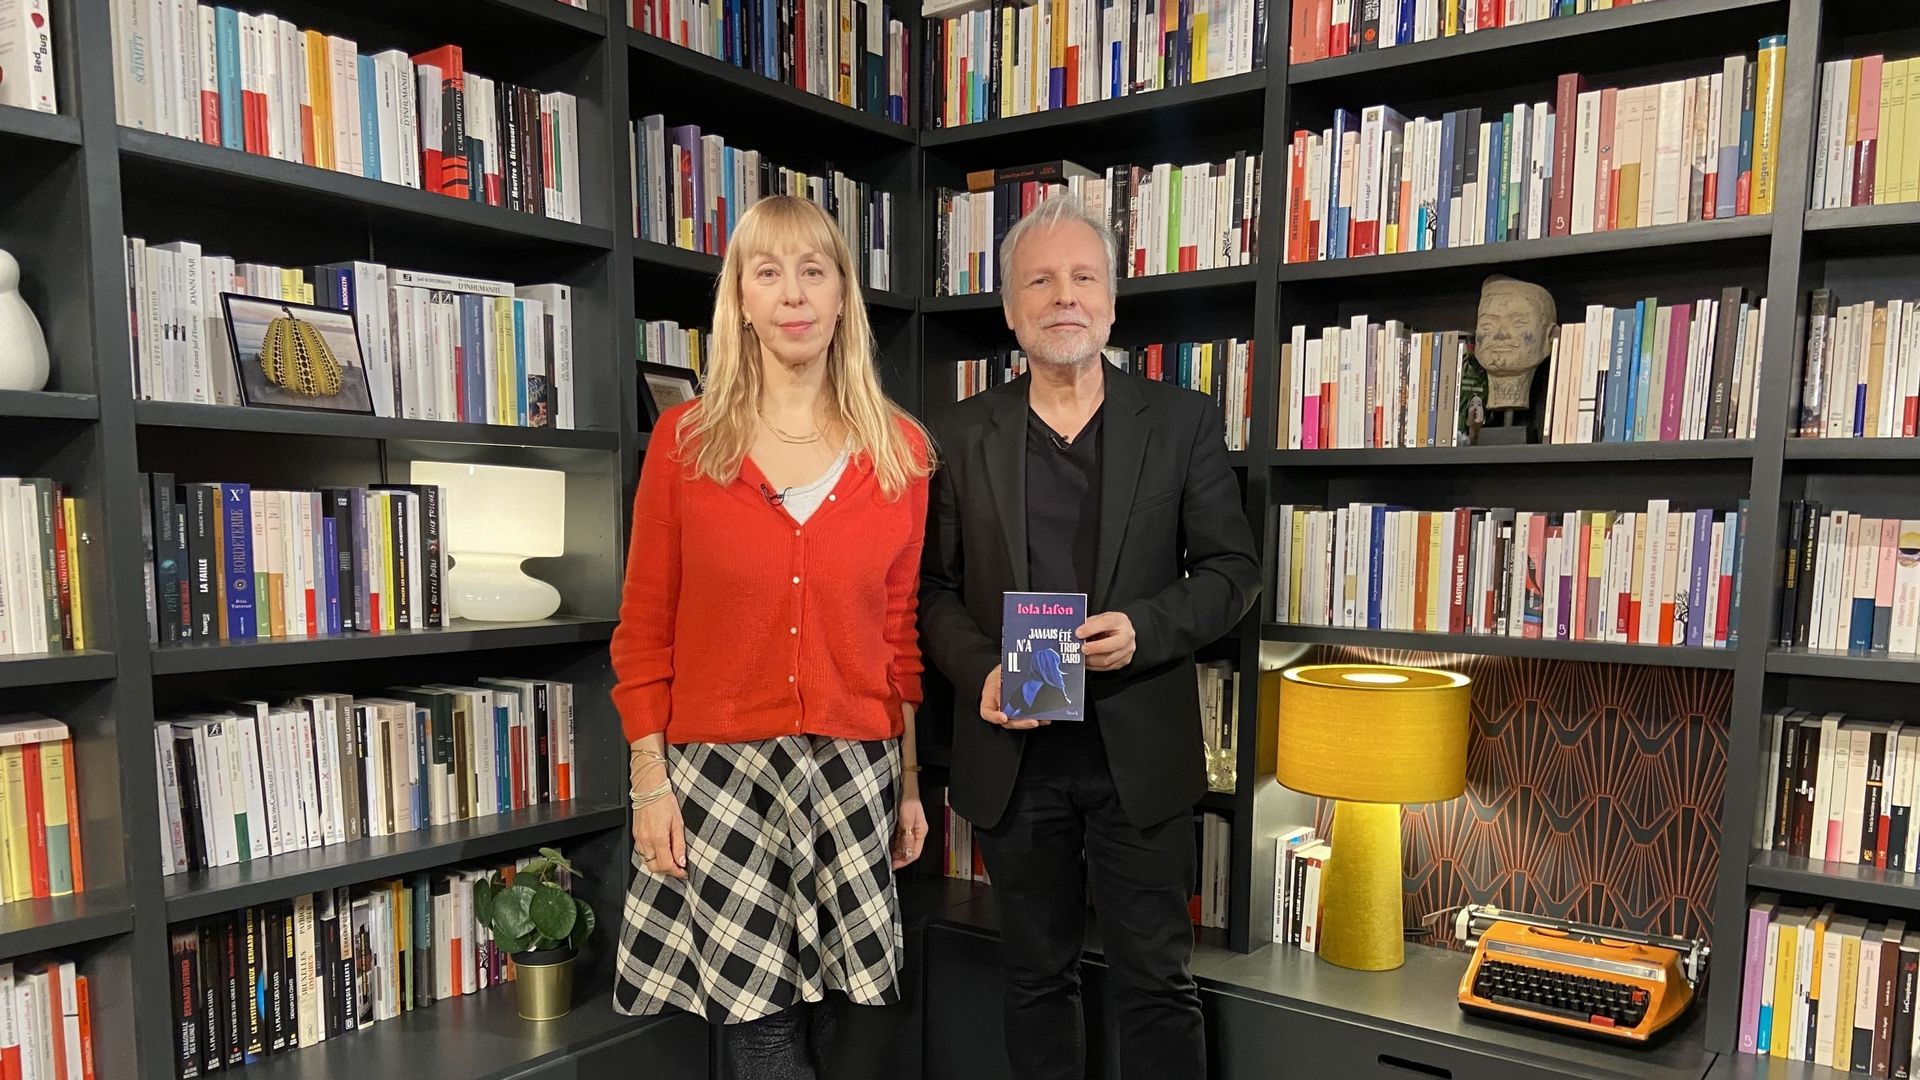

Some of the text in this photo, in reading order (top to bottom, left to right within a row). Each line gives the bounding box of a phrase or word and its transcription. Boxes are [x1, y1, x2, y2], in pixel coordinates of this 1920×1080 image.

[33, 34, 48, 73] Bed Bug
[134, 33, 147, 84] SCHMITT
[1759, 151, 1768, 187] sagesse
[1758, 189, 1766, 200] La
[189, 278, 197, 305] JOANN
[341, 276, 349, 306] BROOKLYN
[231, 509, 246, 574] BORDETERRE
[199, 559, 208, 593] LA FAILLE
[1456, 554, 1464, 574] NÈGRE
[1454, 575, 1464, 605] ÉLASTIQUE
[1017, 603, 1073, 615] lola lafon
[1016, 639, 1032, 653] N'A
[1028, 628, 1058, 640] JAMAIS
[1059, 629, 1072, 642] ÉTÉ
[1059, 643, 1080, 653] TROP
[1061, 653, 1080, 664] TARD
[1008, 652, 1020, 672] IL
[167, 767, 175, 787] Bernard
[298, 904, 306, 934] PATRICK
[247, 935, 255, 964] BERNARD
[182, 959, 192, 1017] BERNARD WERBER
[248, 967, 256, 986] DIEUX
[249, 998, 257, 1025] MYSTÈRE
